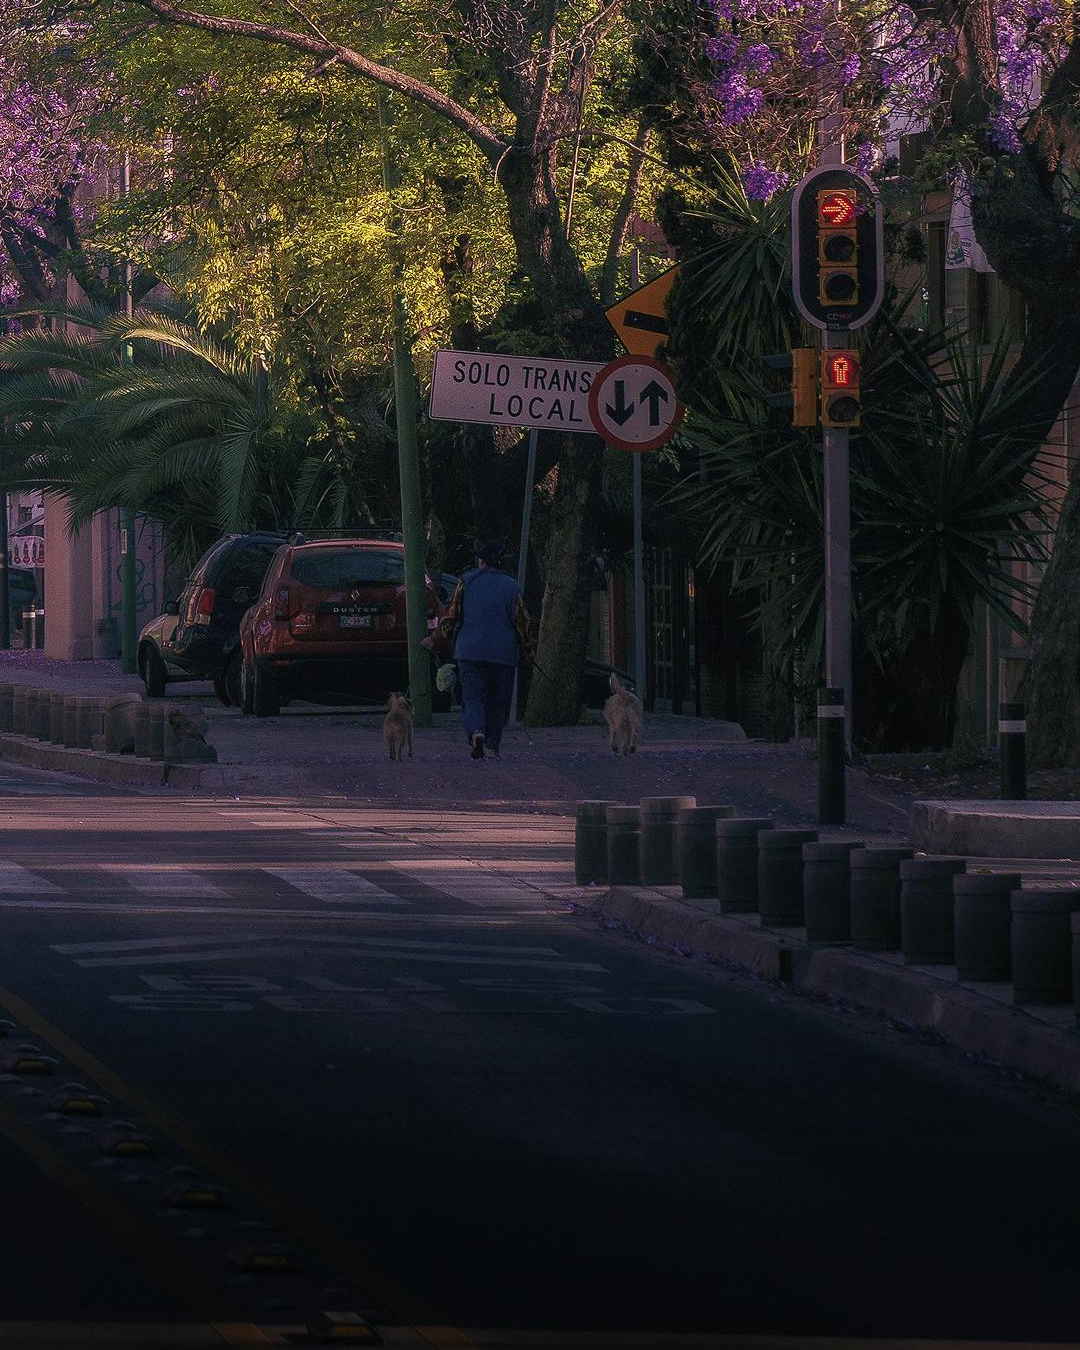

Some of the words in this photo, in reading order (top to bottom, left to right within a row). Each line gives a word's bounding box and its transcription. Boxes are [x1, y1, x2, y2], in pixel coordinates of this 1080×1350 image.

[453, 360, 510, 387] SOLO
[522, 366, 598, 394] TRANS
[489, 393, 583, 423] LOCAL
